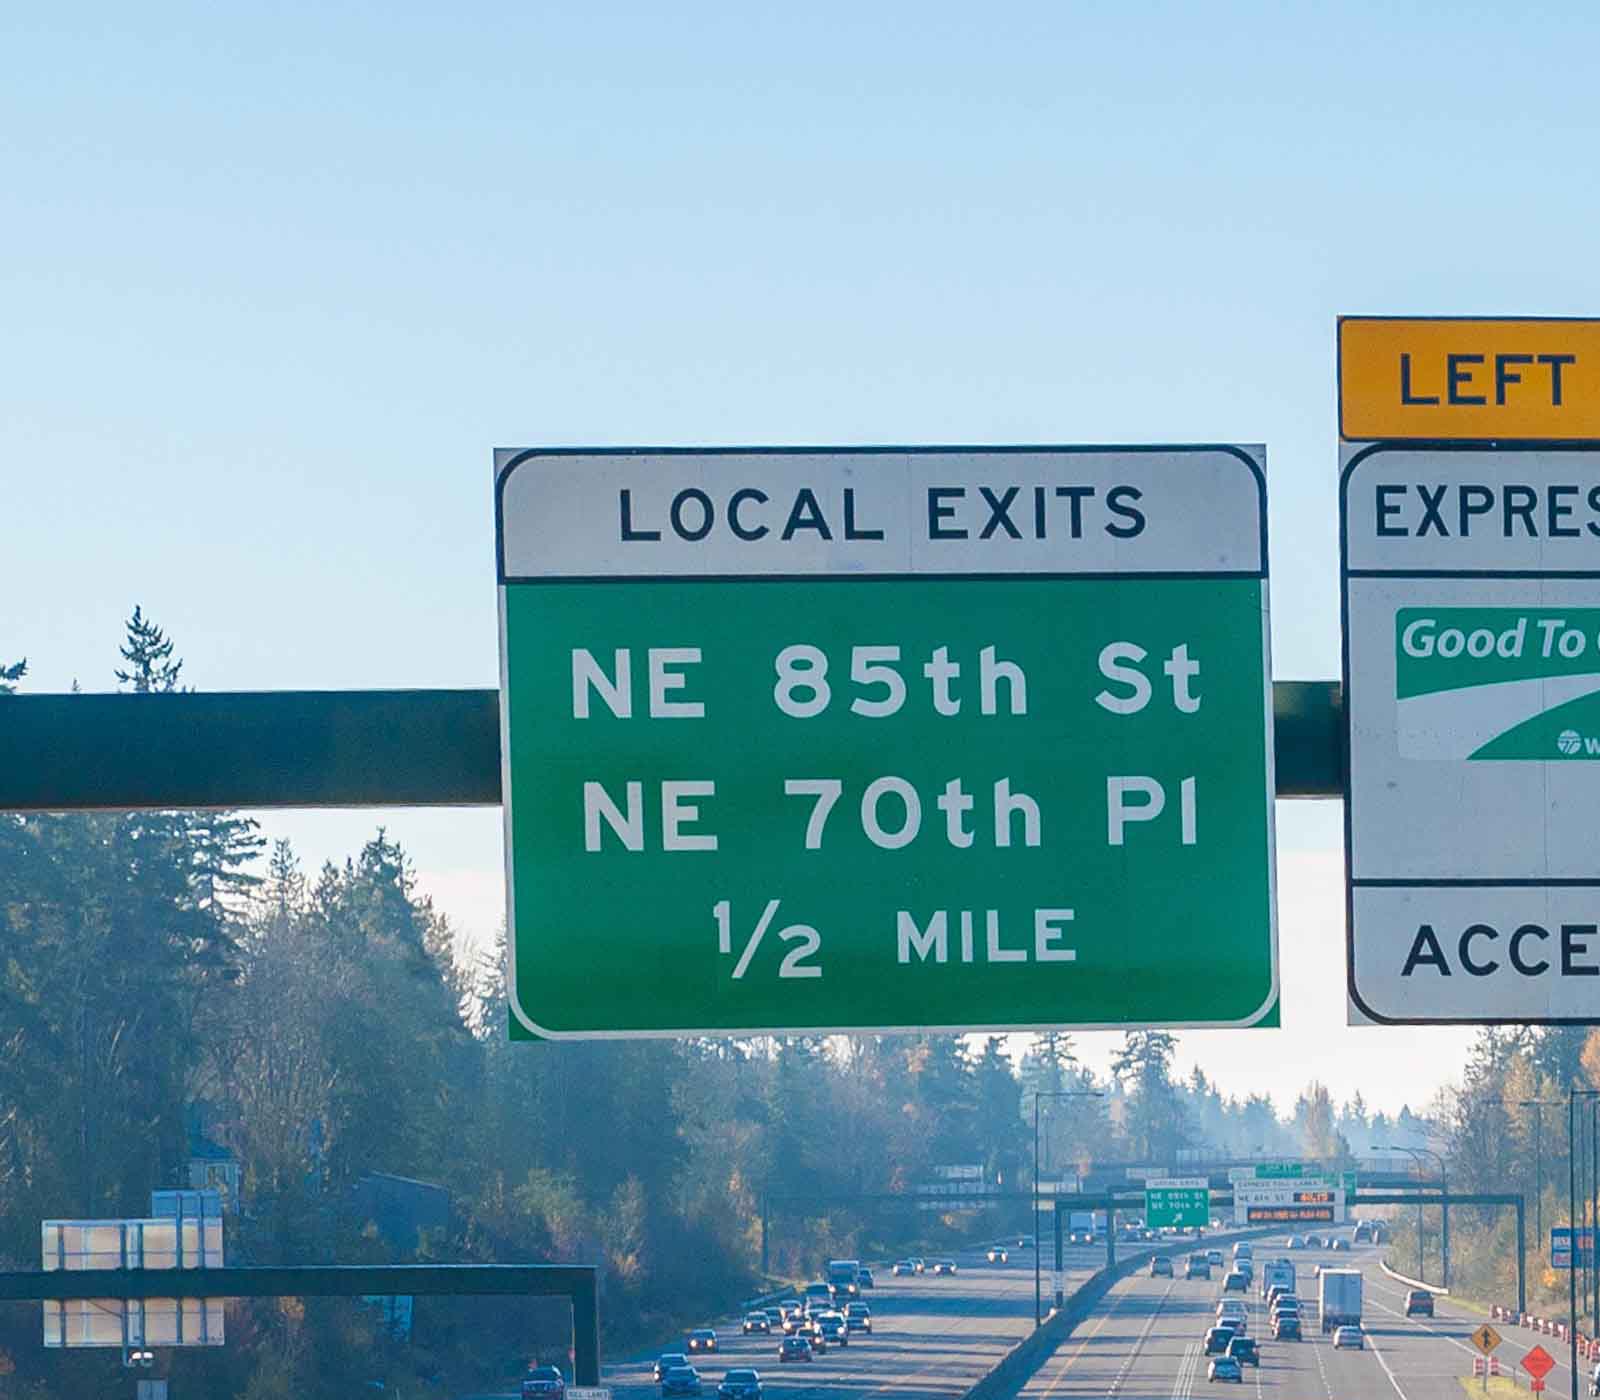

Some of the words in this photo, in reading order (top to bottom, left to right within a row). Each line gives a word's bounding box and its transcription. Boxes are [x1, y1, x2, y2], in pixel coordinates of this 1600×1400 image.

[1400, 352, 1577, 407] LEFT
[619, 487, 885, 542] LOCAL
[928, 484, 1148, 541] EXITS
[1401, 618, 1528, 660] Good
[1536, 618, 1588, 659] To
[571, 646, 705, 720] NE
[773, 643, 1028, 719] 85th
[1095, 641, 1202, 716] St
[583, 780, 718, 852] NE
[784, 775, 1042, 850] 70th
[1106, 775, 1197, 847] Pl
[712, 899, 823, 979] 1/2
[897, 908, 1077, 964] MILE
